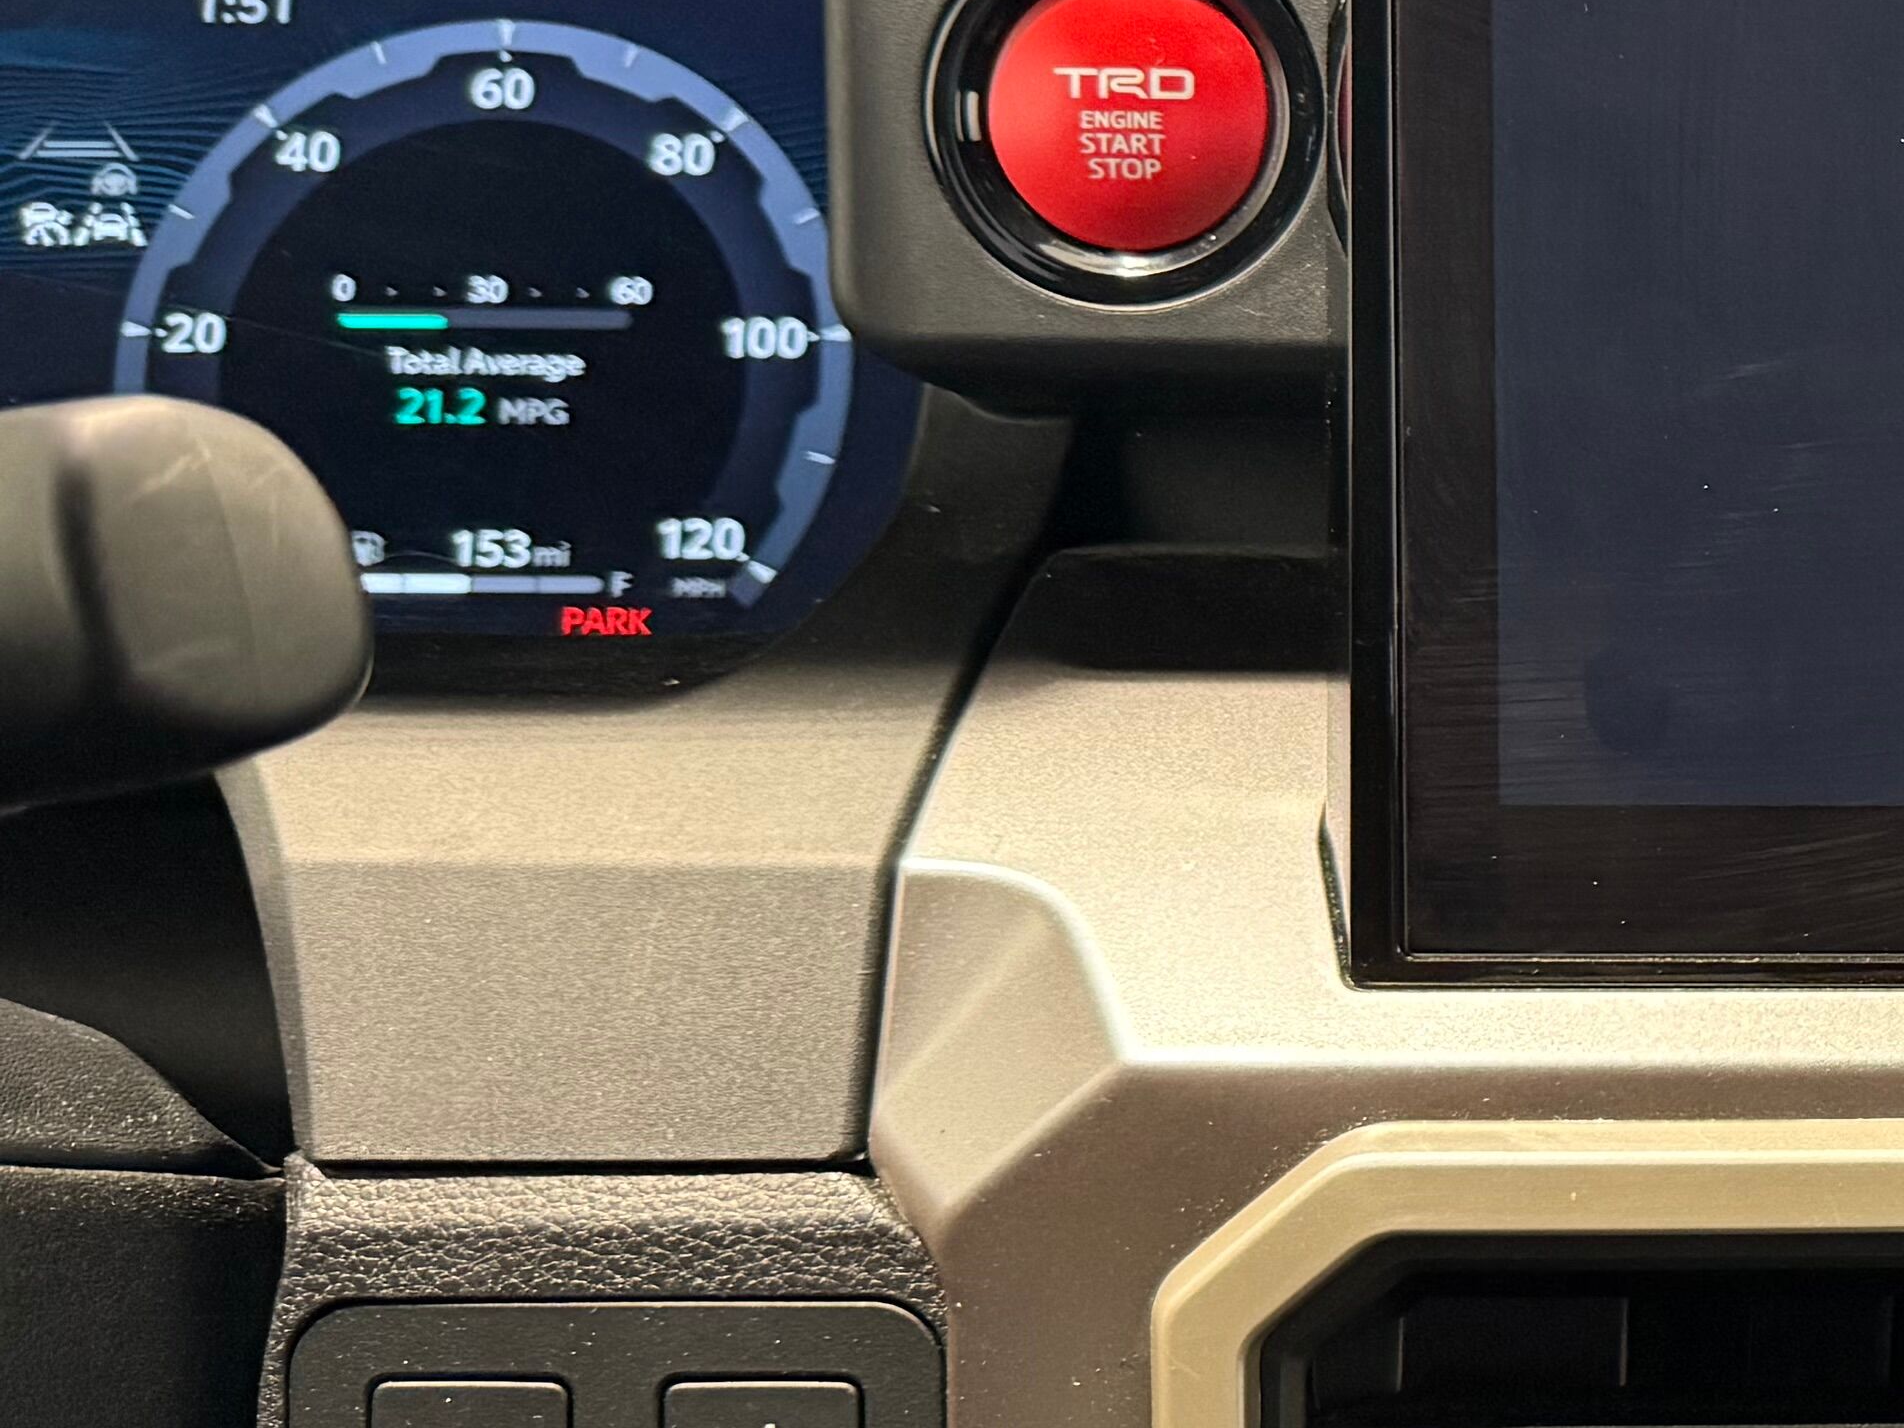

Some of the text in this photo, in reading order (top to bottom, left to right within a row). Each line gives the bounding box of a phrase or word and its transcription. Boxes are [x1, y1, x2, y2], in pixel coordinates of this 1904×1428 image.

[471, 70, 535, 109] 60
[1054, 67, 1195, 100] TRD
[1080, 111, 1164, 130] ENGINE
[275, 131, 341, 173] 40
[650, 135, 714, 175] 80
[1079, 134, 1165, 156] START
[1088, 158, 1162, 180] STOP
[331, 274, 356, 302] 0
[465, 275, 509, 304] 30
[609, 276, 653, 305] 60
[162, 313, 226, 354] 20
[724, 317, 807, 359] 100
[386, 346, 586, 383] Total Average
[396, 387, 570, 425] 21.2 MPG
[452, 529, 571, 567] 153 mi
[657, 518, 744, 560] 120
[610, 571, 633, 597] F
[561, 606, 653, 636] PARK
